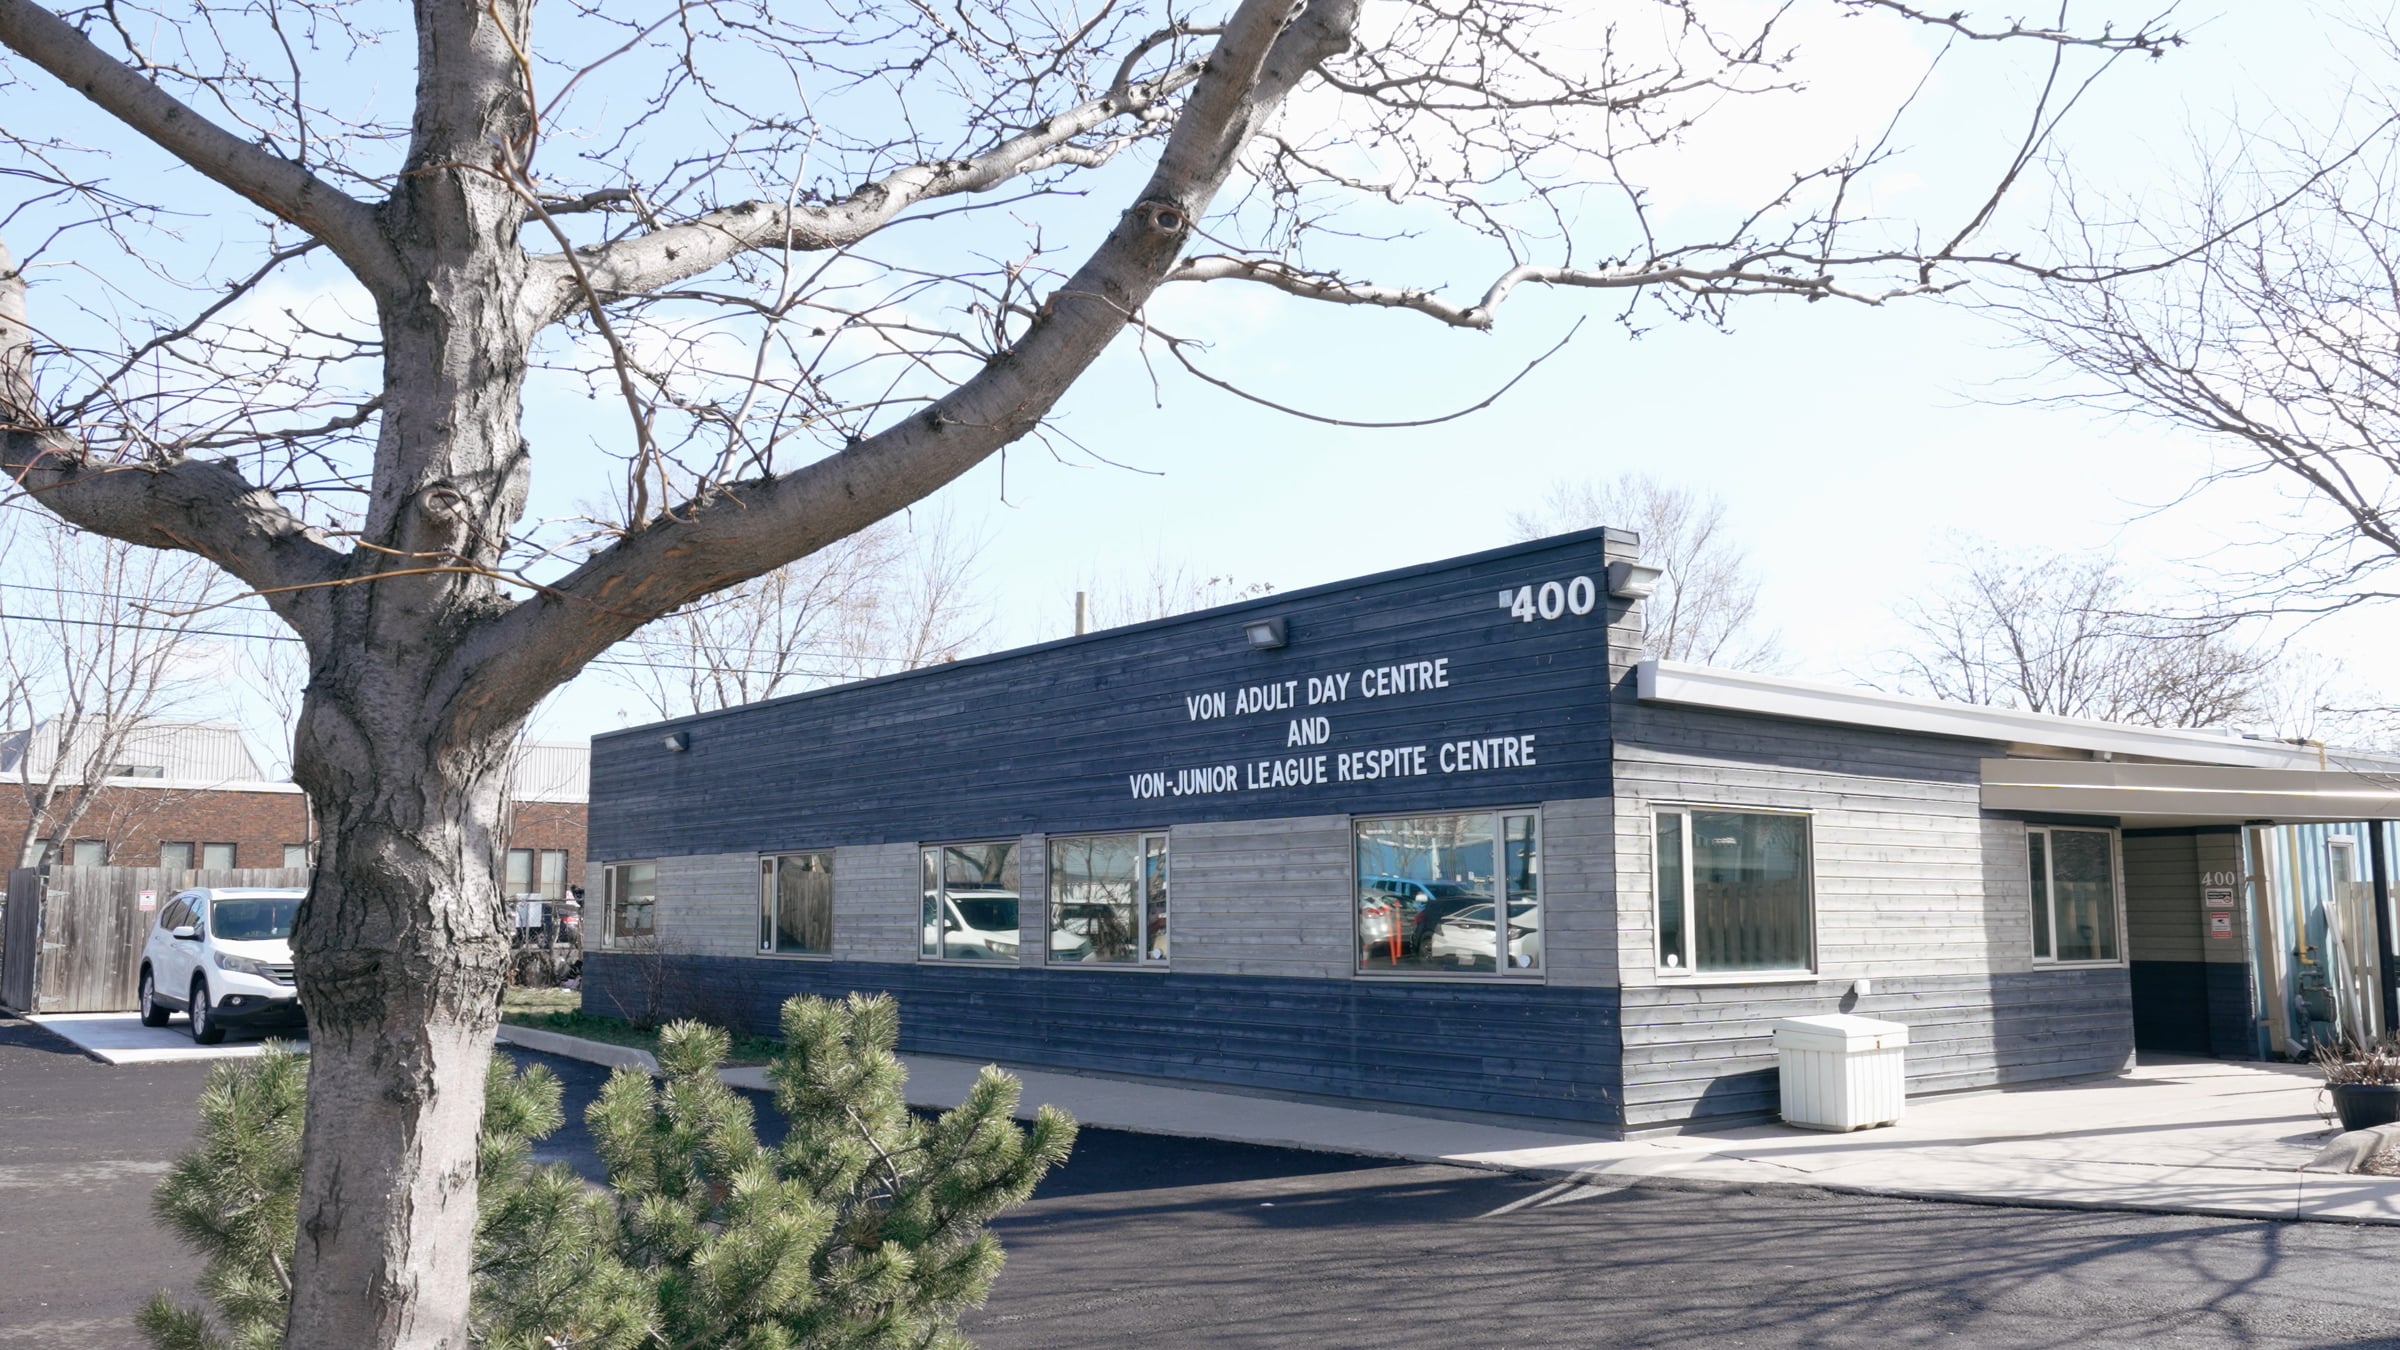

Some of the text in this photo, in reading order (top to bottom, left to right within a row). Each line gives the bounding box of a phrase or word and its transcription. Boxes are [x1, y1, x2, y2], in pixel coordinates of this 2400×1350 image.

[1511, 576, 1595, 623] 400
[1187, 658, 1449, 721] VON ADULT DAY CENTRE
[1287, 717, 1330, 747] AND
[1130, 735, 1536, 799] VON-JUNIOR LEAGUE RESPITE CENTRE
[2201, 871, 2235, 886] 400
